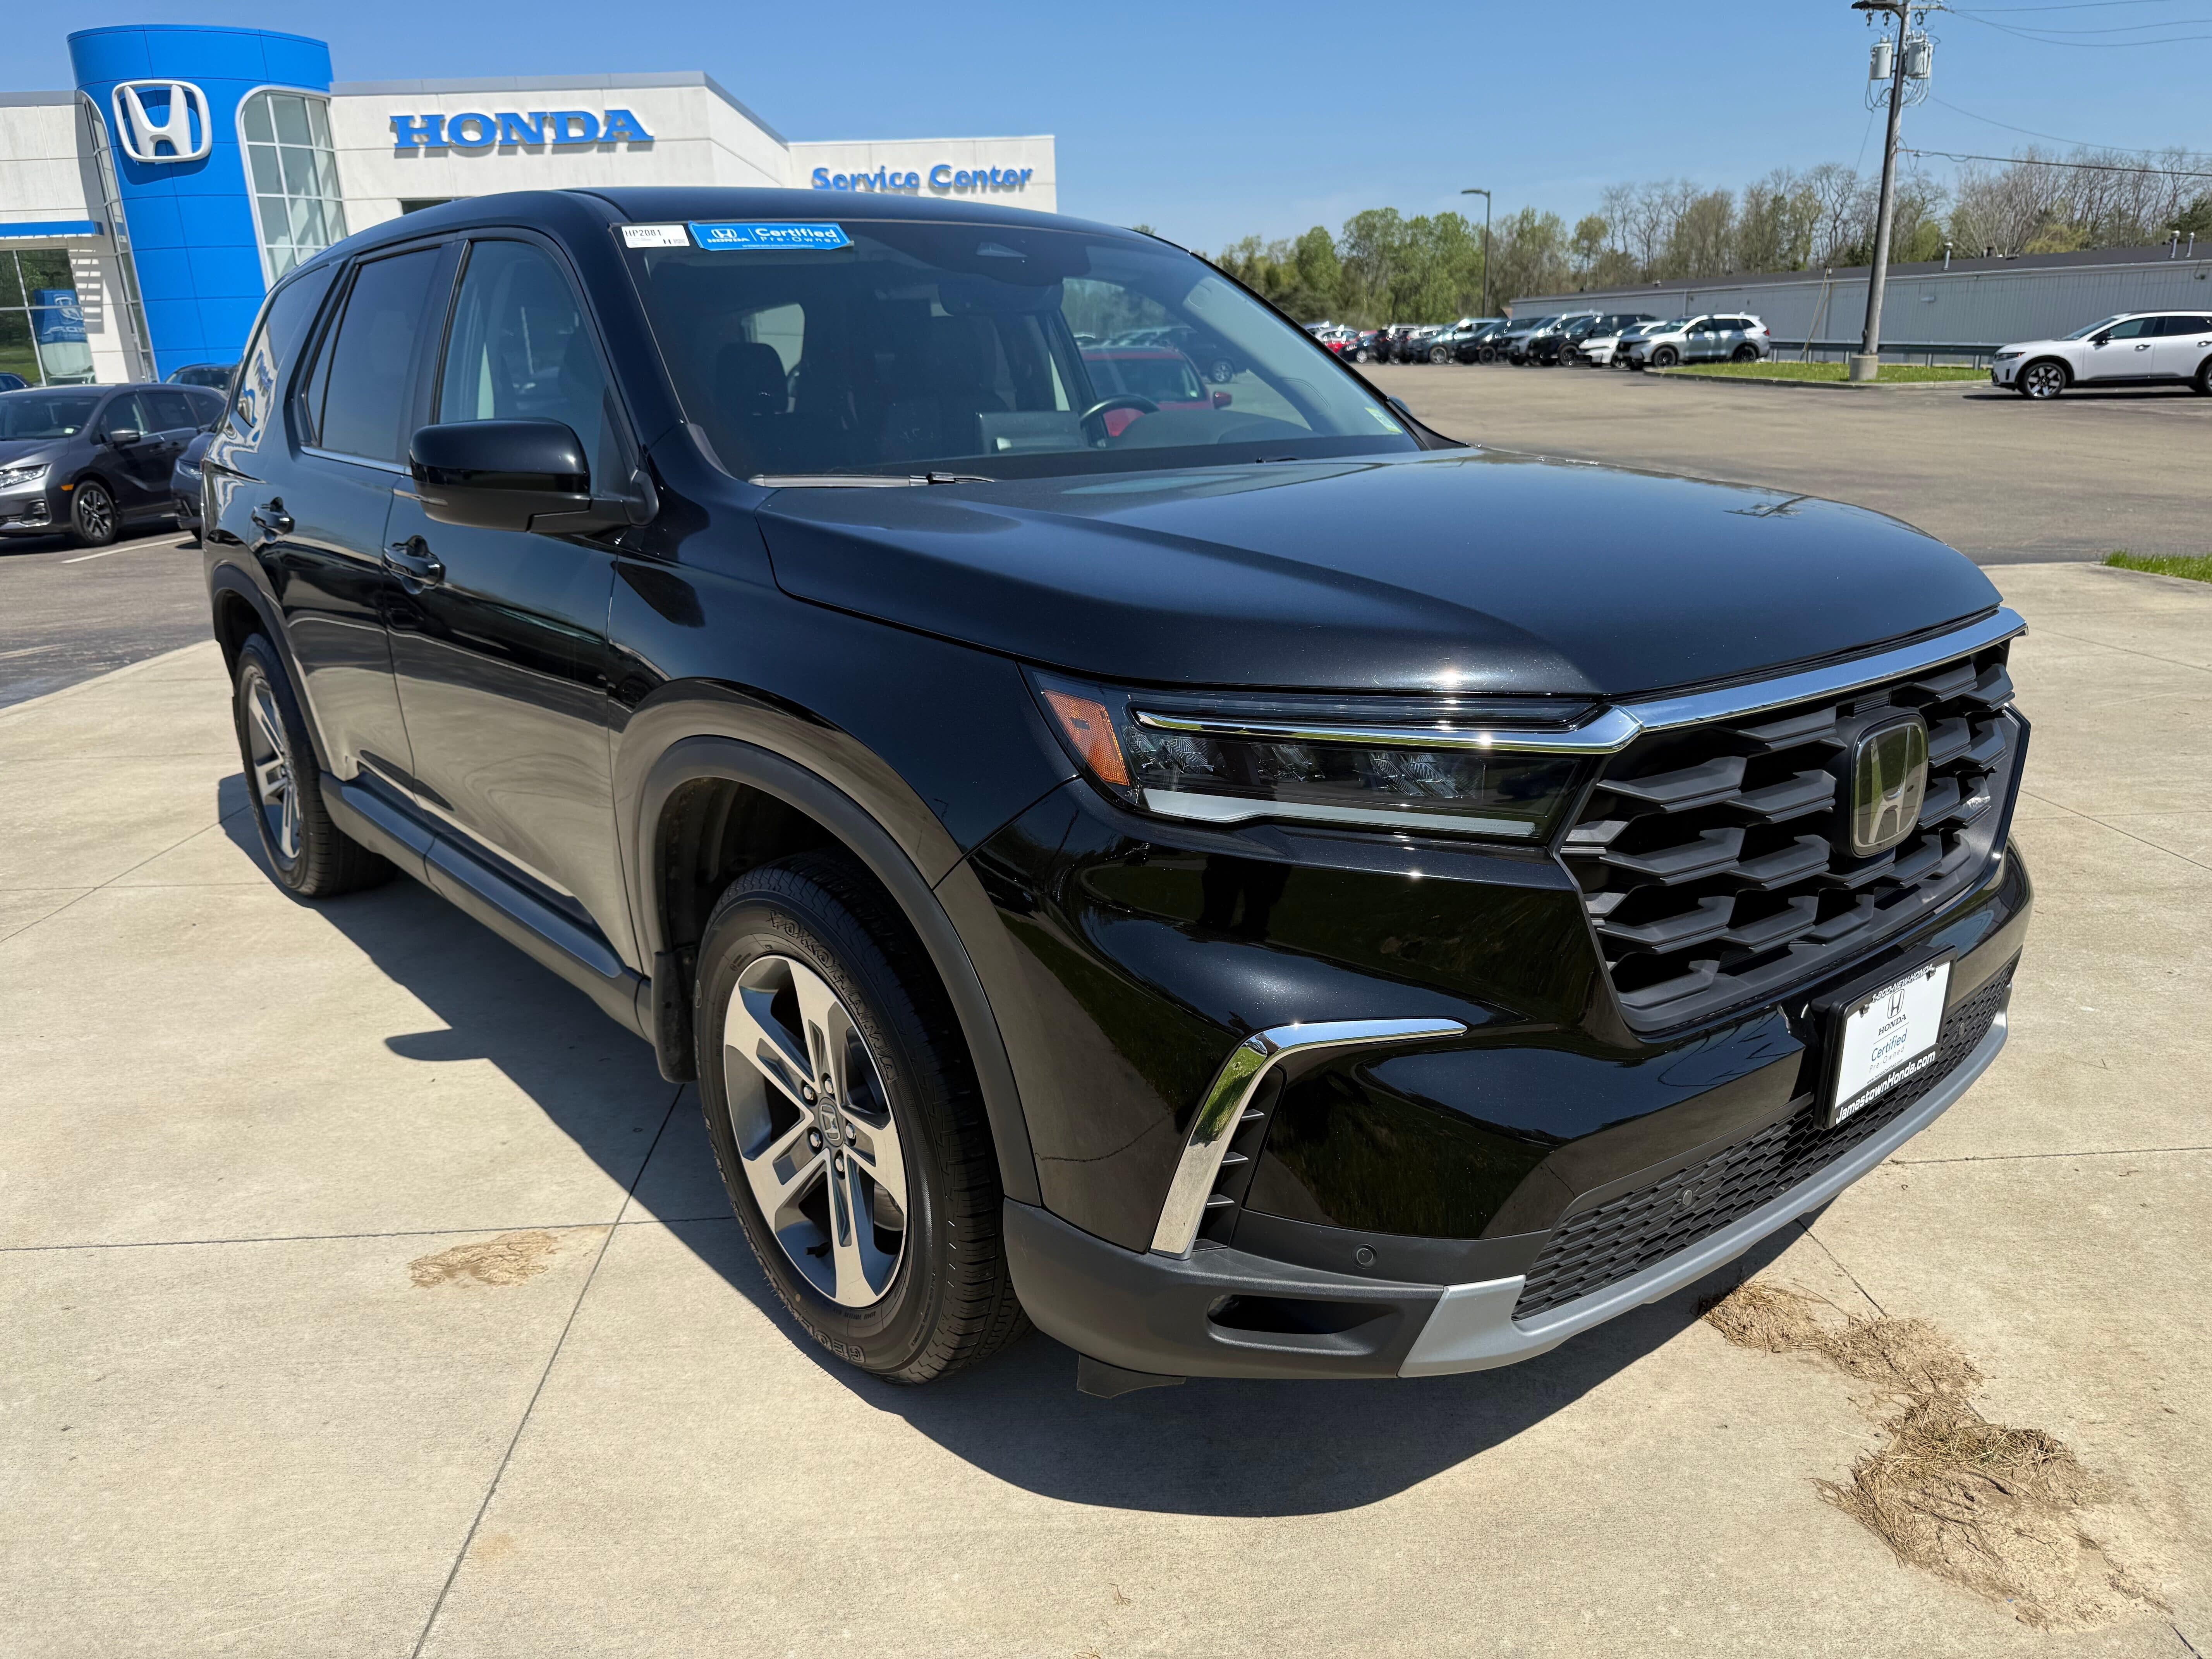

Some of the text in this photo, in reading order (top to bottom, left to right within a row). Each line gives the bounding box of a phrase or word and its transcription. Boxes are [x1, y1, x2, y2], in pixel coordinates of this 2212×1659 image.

[390, 110, 654, 148] HONDA
[812, 164, 1033, 191] Service Center
[755, 228, 837, 238] Certified
[1878, 1014, 1906, 1036] HONDA
[1869, 1044, 1905, 1073] Pre-Owned
[1871, 1028, 1908, 1062] Certified
[1836, 1051, 1936, 1125] JamestownHonda.com
